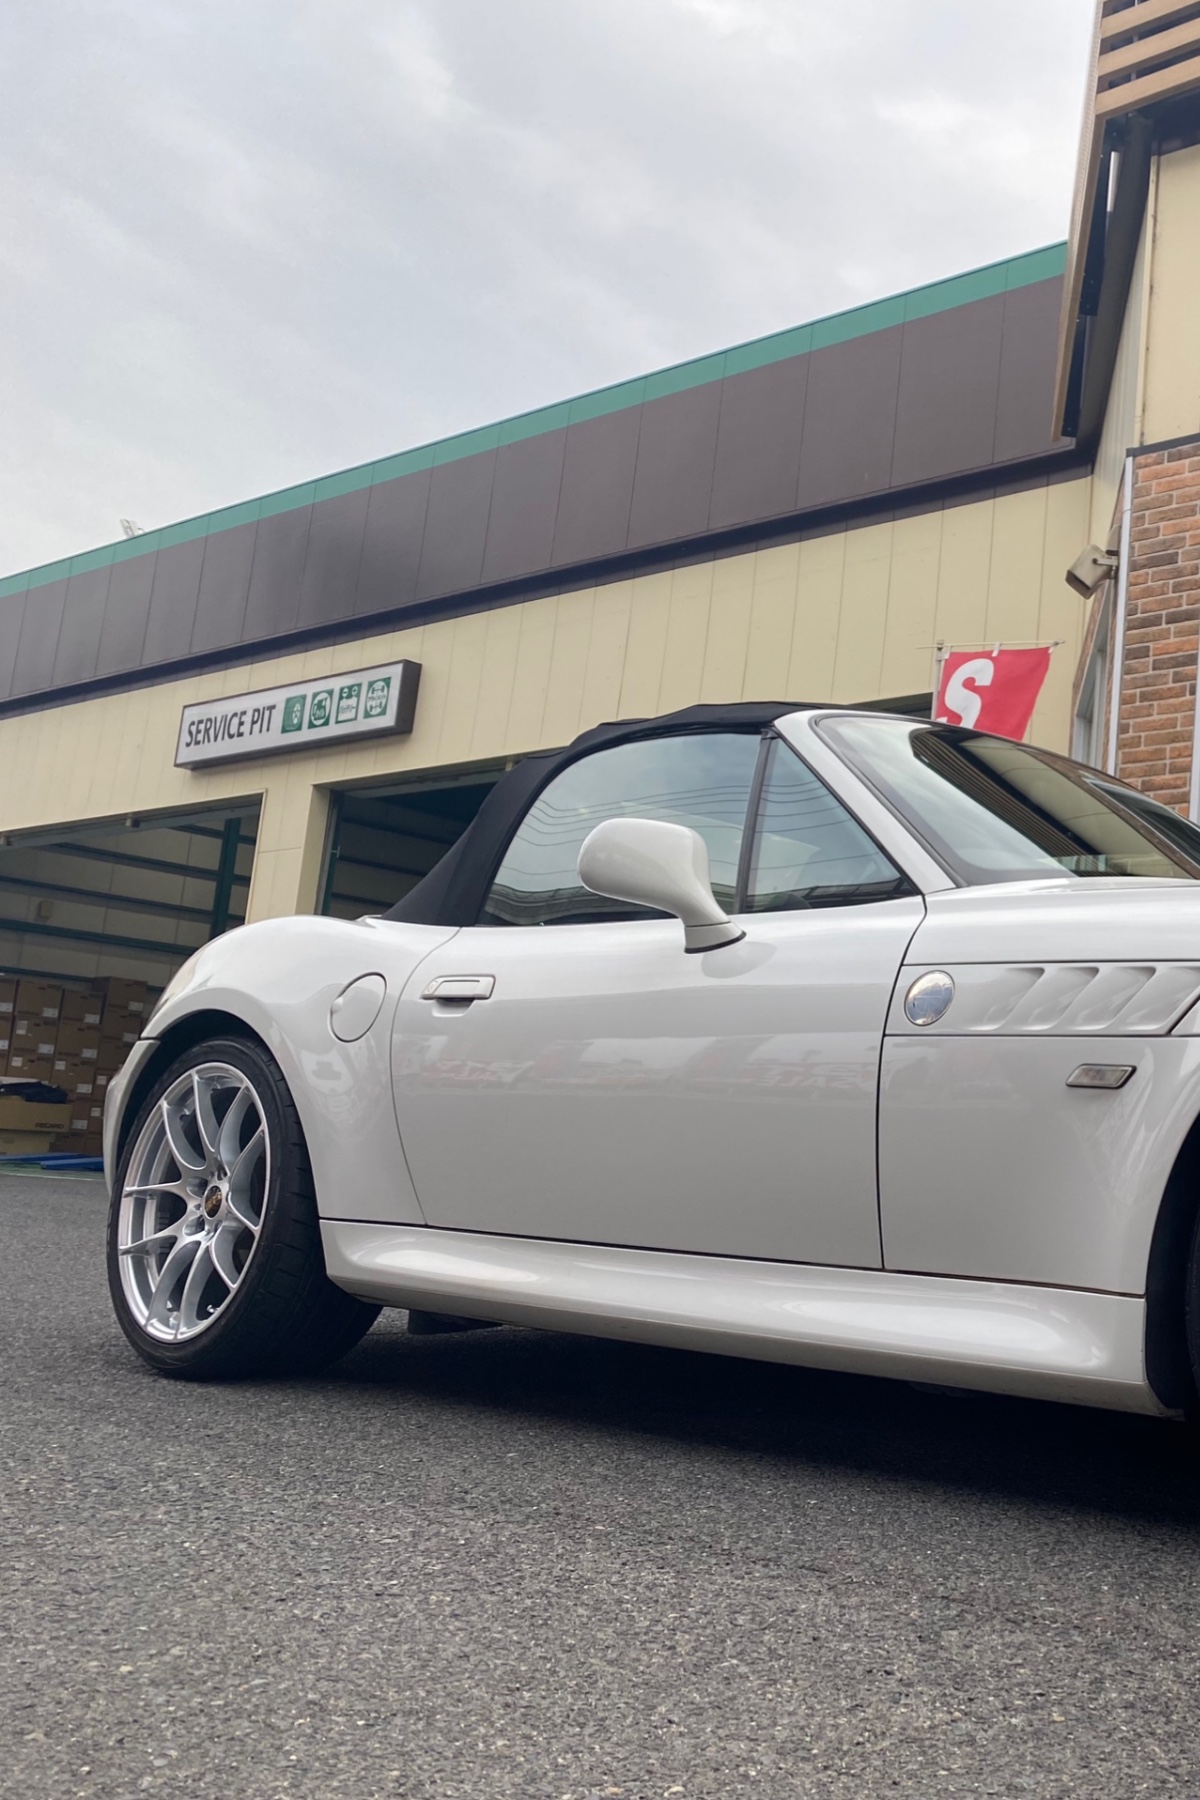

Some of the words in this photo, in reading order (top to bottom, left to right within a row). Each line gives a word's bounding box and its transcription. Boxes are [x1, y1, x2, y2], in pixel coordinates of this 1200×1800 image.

[936, 658, 995, 729] S
[185, 710, 247, 748] SERVICE
[249, 704, 276, 736] PIT
